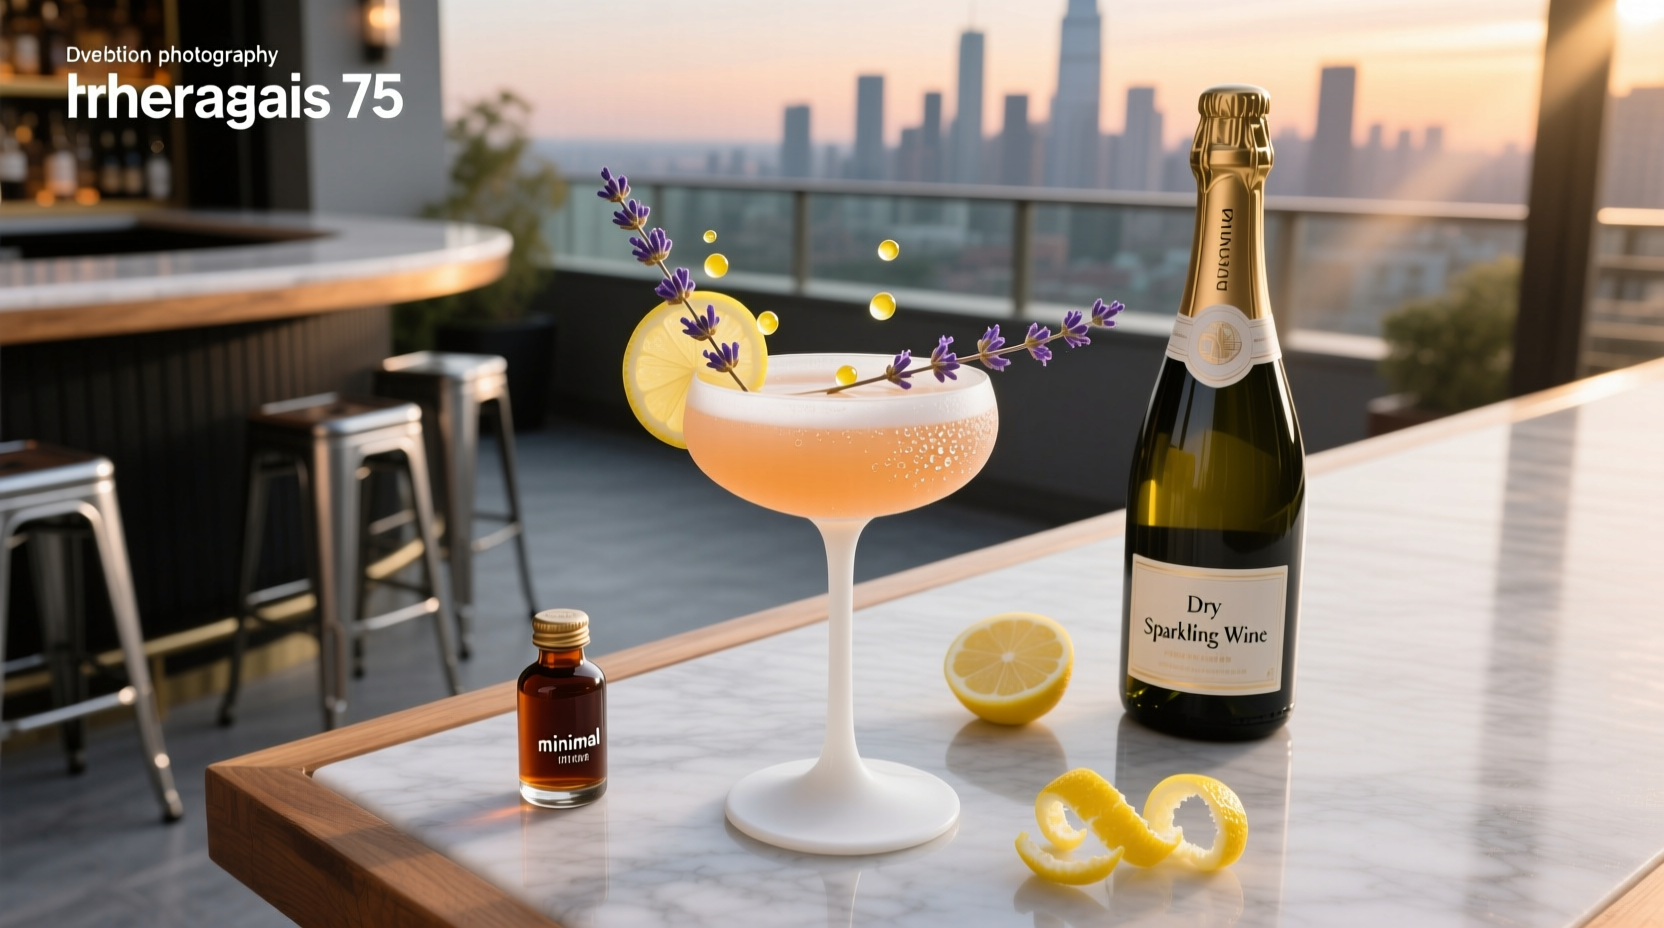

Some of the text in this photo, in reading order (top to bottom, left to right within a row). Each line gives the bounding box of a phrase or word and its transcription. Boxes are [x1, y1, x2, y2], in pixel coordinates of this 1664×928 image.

[1186, 594, 1222, 621] Dry
[1143, 616, 1269, 650] Sparkling Wine
[538, 727, 600, 753] minimal
